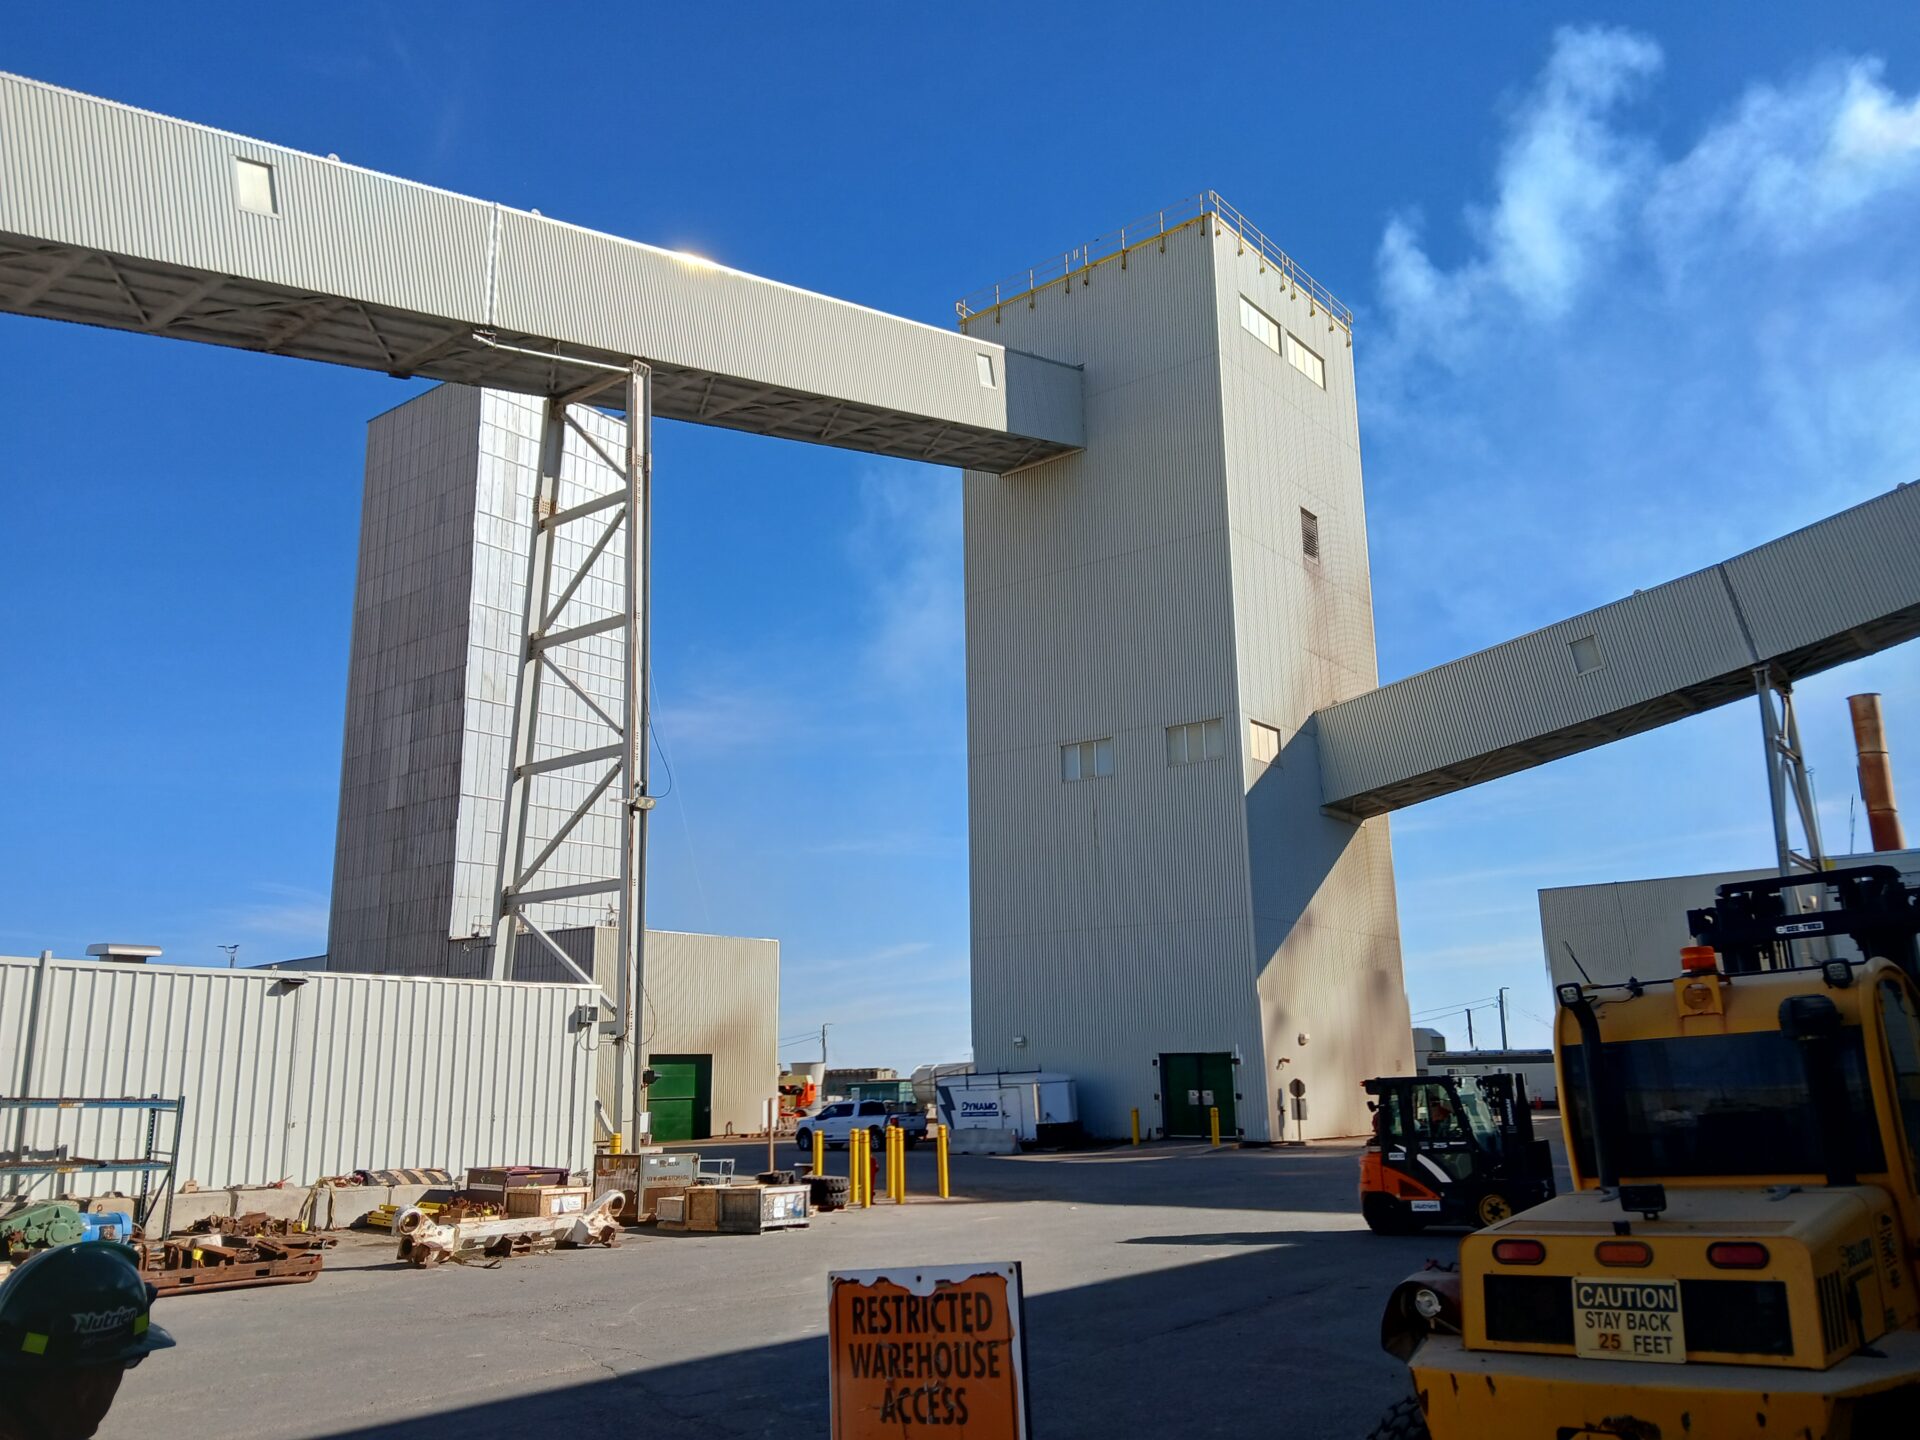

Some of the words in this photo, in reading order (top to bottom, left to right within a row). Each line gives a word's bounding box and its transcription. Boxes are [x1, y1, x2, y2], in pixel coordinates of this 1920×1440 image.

[962, 1101, 998, 1111] DYNAMO
[1579, 1286, 1675, 1310] CAUTION
[72, 1305, 138, 1334] Nutrien
[851, 1292, 993, 1335] RESTRICTED
[1585, 1311, 1621, 1330] STAY
[1626, 1312, 1671, 1332] BACK
[1600, 1333, 1622, 1350] 25
[1633, 1335, 1673, 1354] FEET
[849, 1340, 1001, 1379] WAREHOUSE
[879, 1386, 969, 1425] ACCESS
